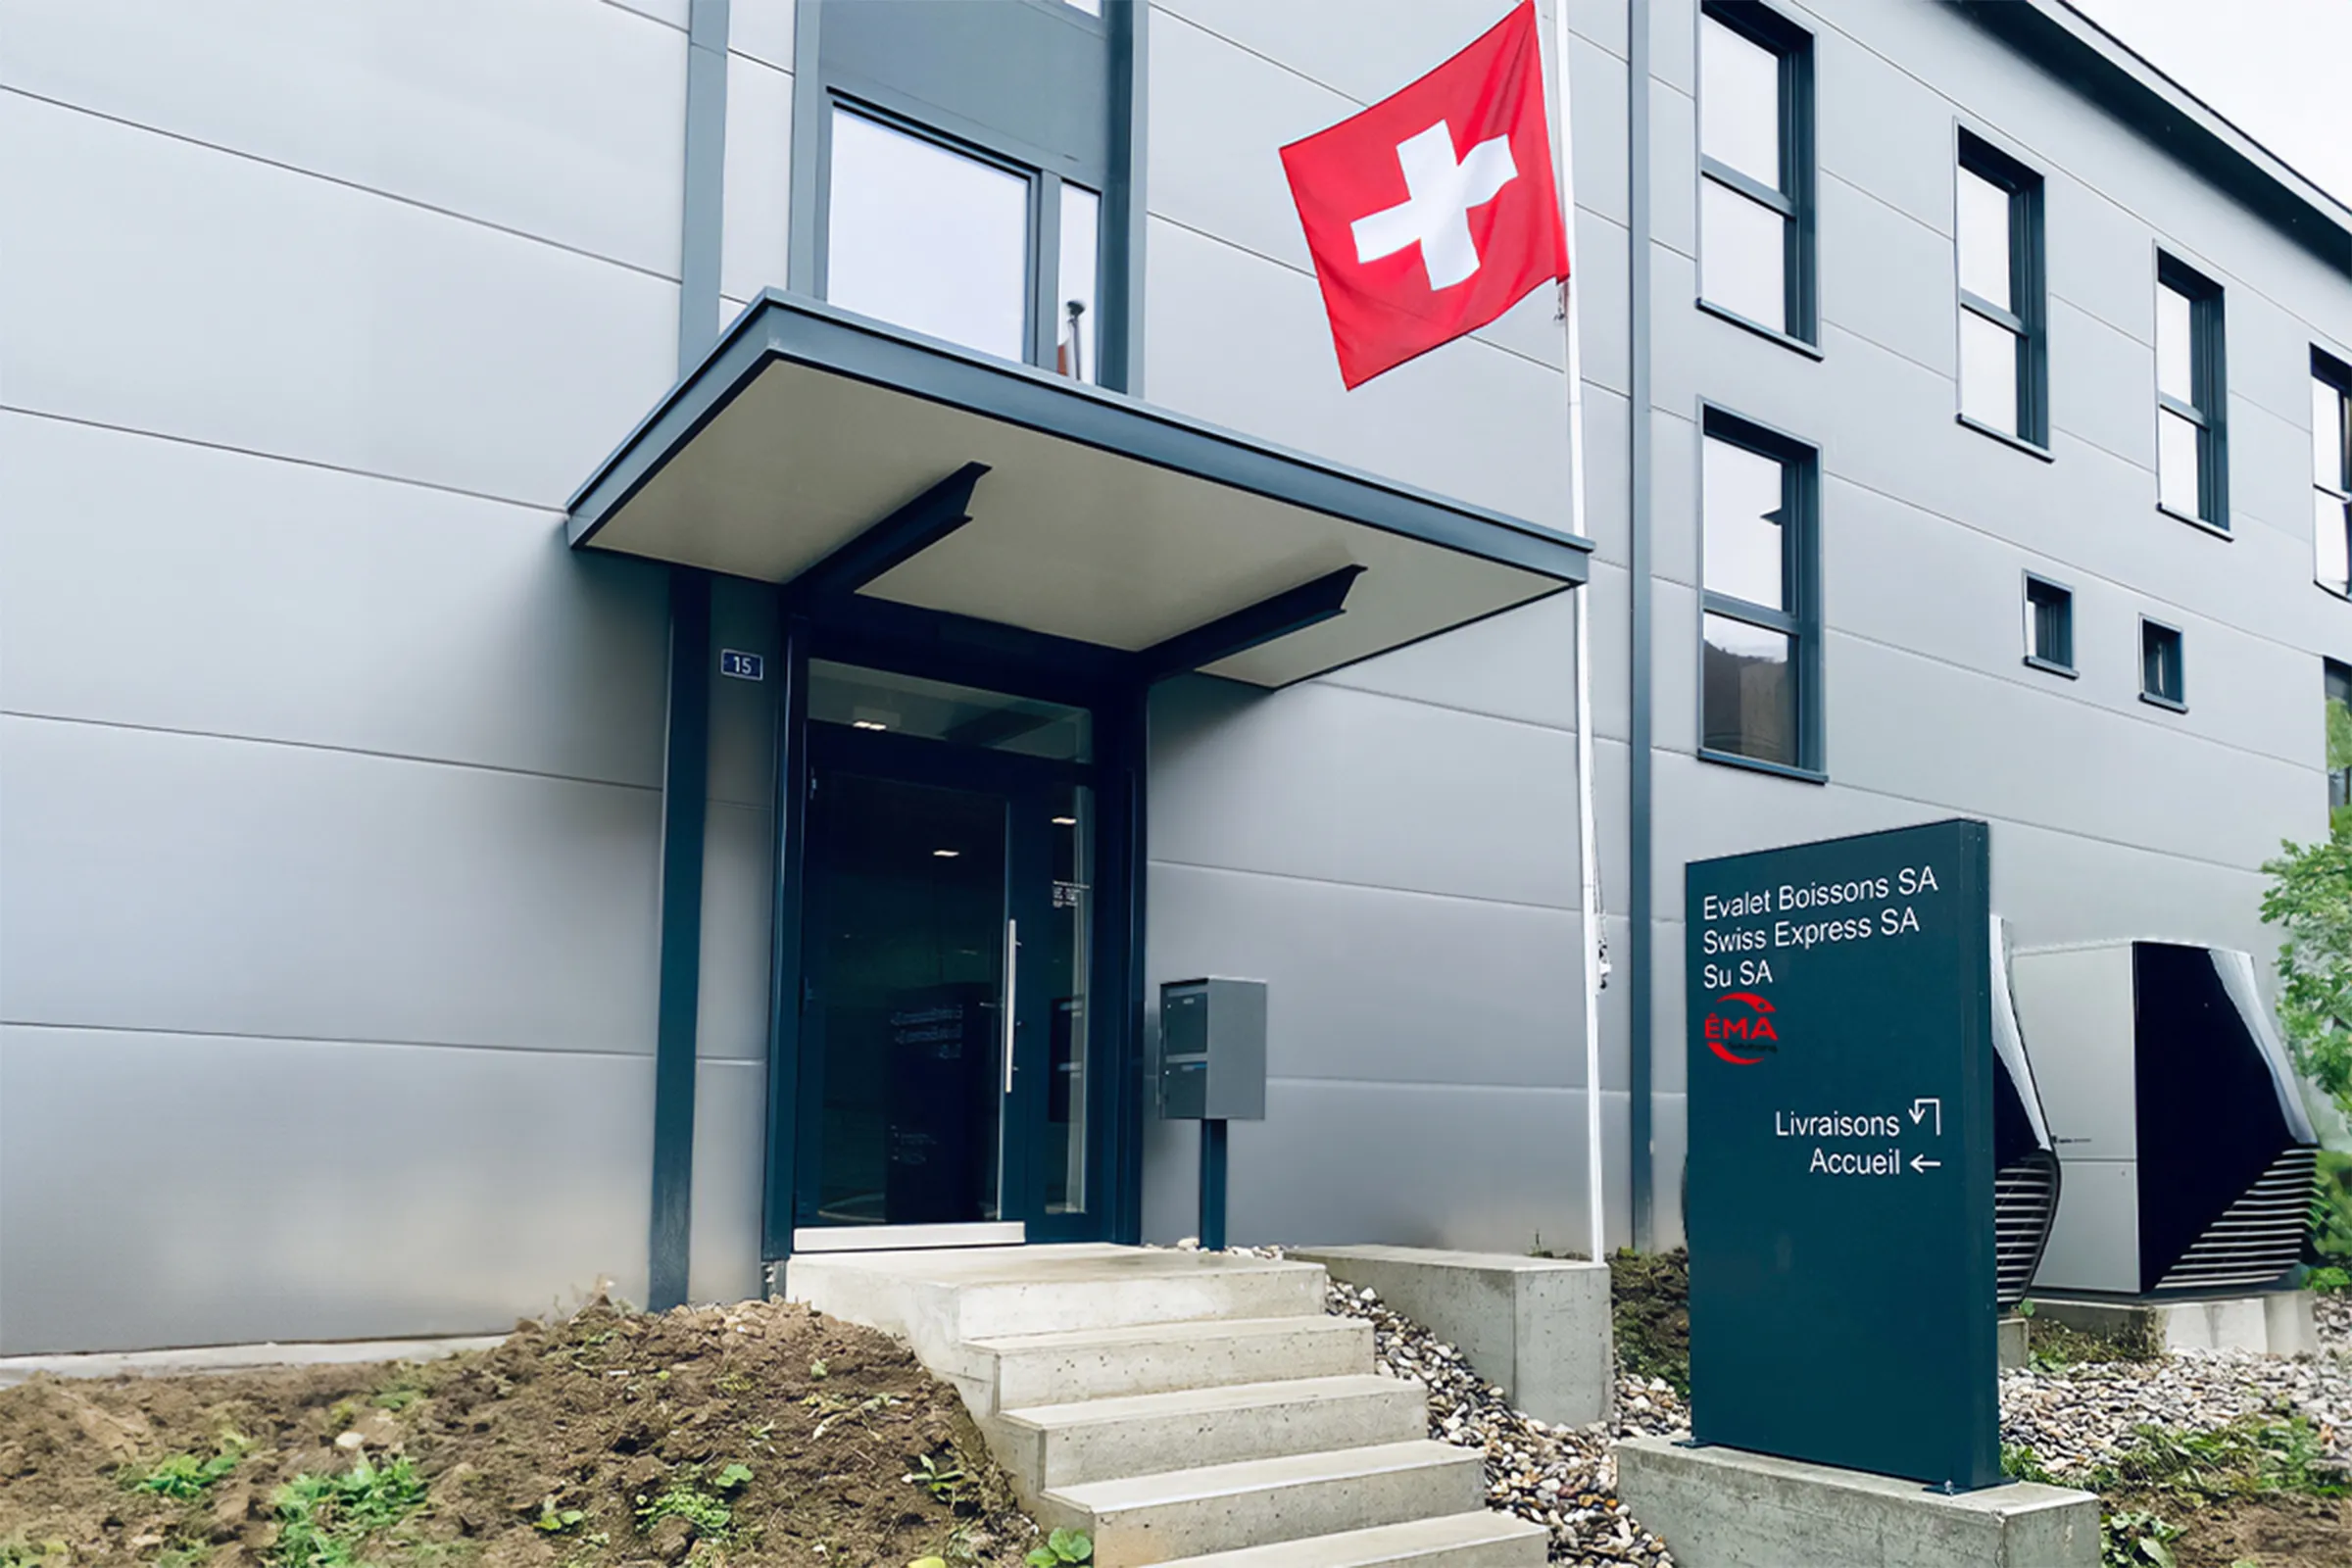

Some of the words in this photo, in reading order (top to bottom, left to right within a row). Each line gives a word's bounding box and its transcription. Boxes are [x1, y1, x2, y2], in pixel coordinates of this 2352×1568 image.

[733, 656, 753, 674] 15
[1703, 889, 1772, 920] Evalet
[1779, 877, 1889, 910] Boissons
[1898, 865, 1939, 896] SA
[1703, 926, 1767, 955] Swiss
[1775, 917, 1873, 950] Express
[1881, 906, 1920, 936] SA
[1703, 963, 1732, 989] Su
[1740, 958, 1774, 986] SA
[1776, 1110, 1900, 1137] Livraisons
[1809, 1147, 1900, 1175] Accueil
